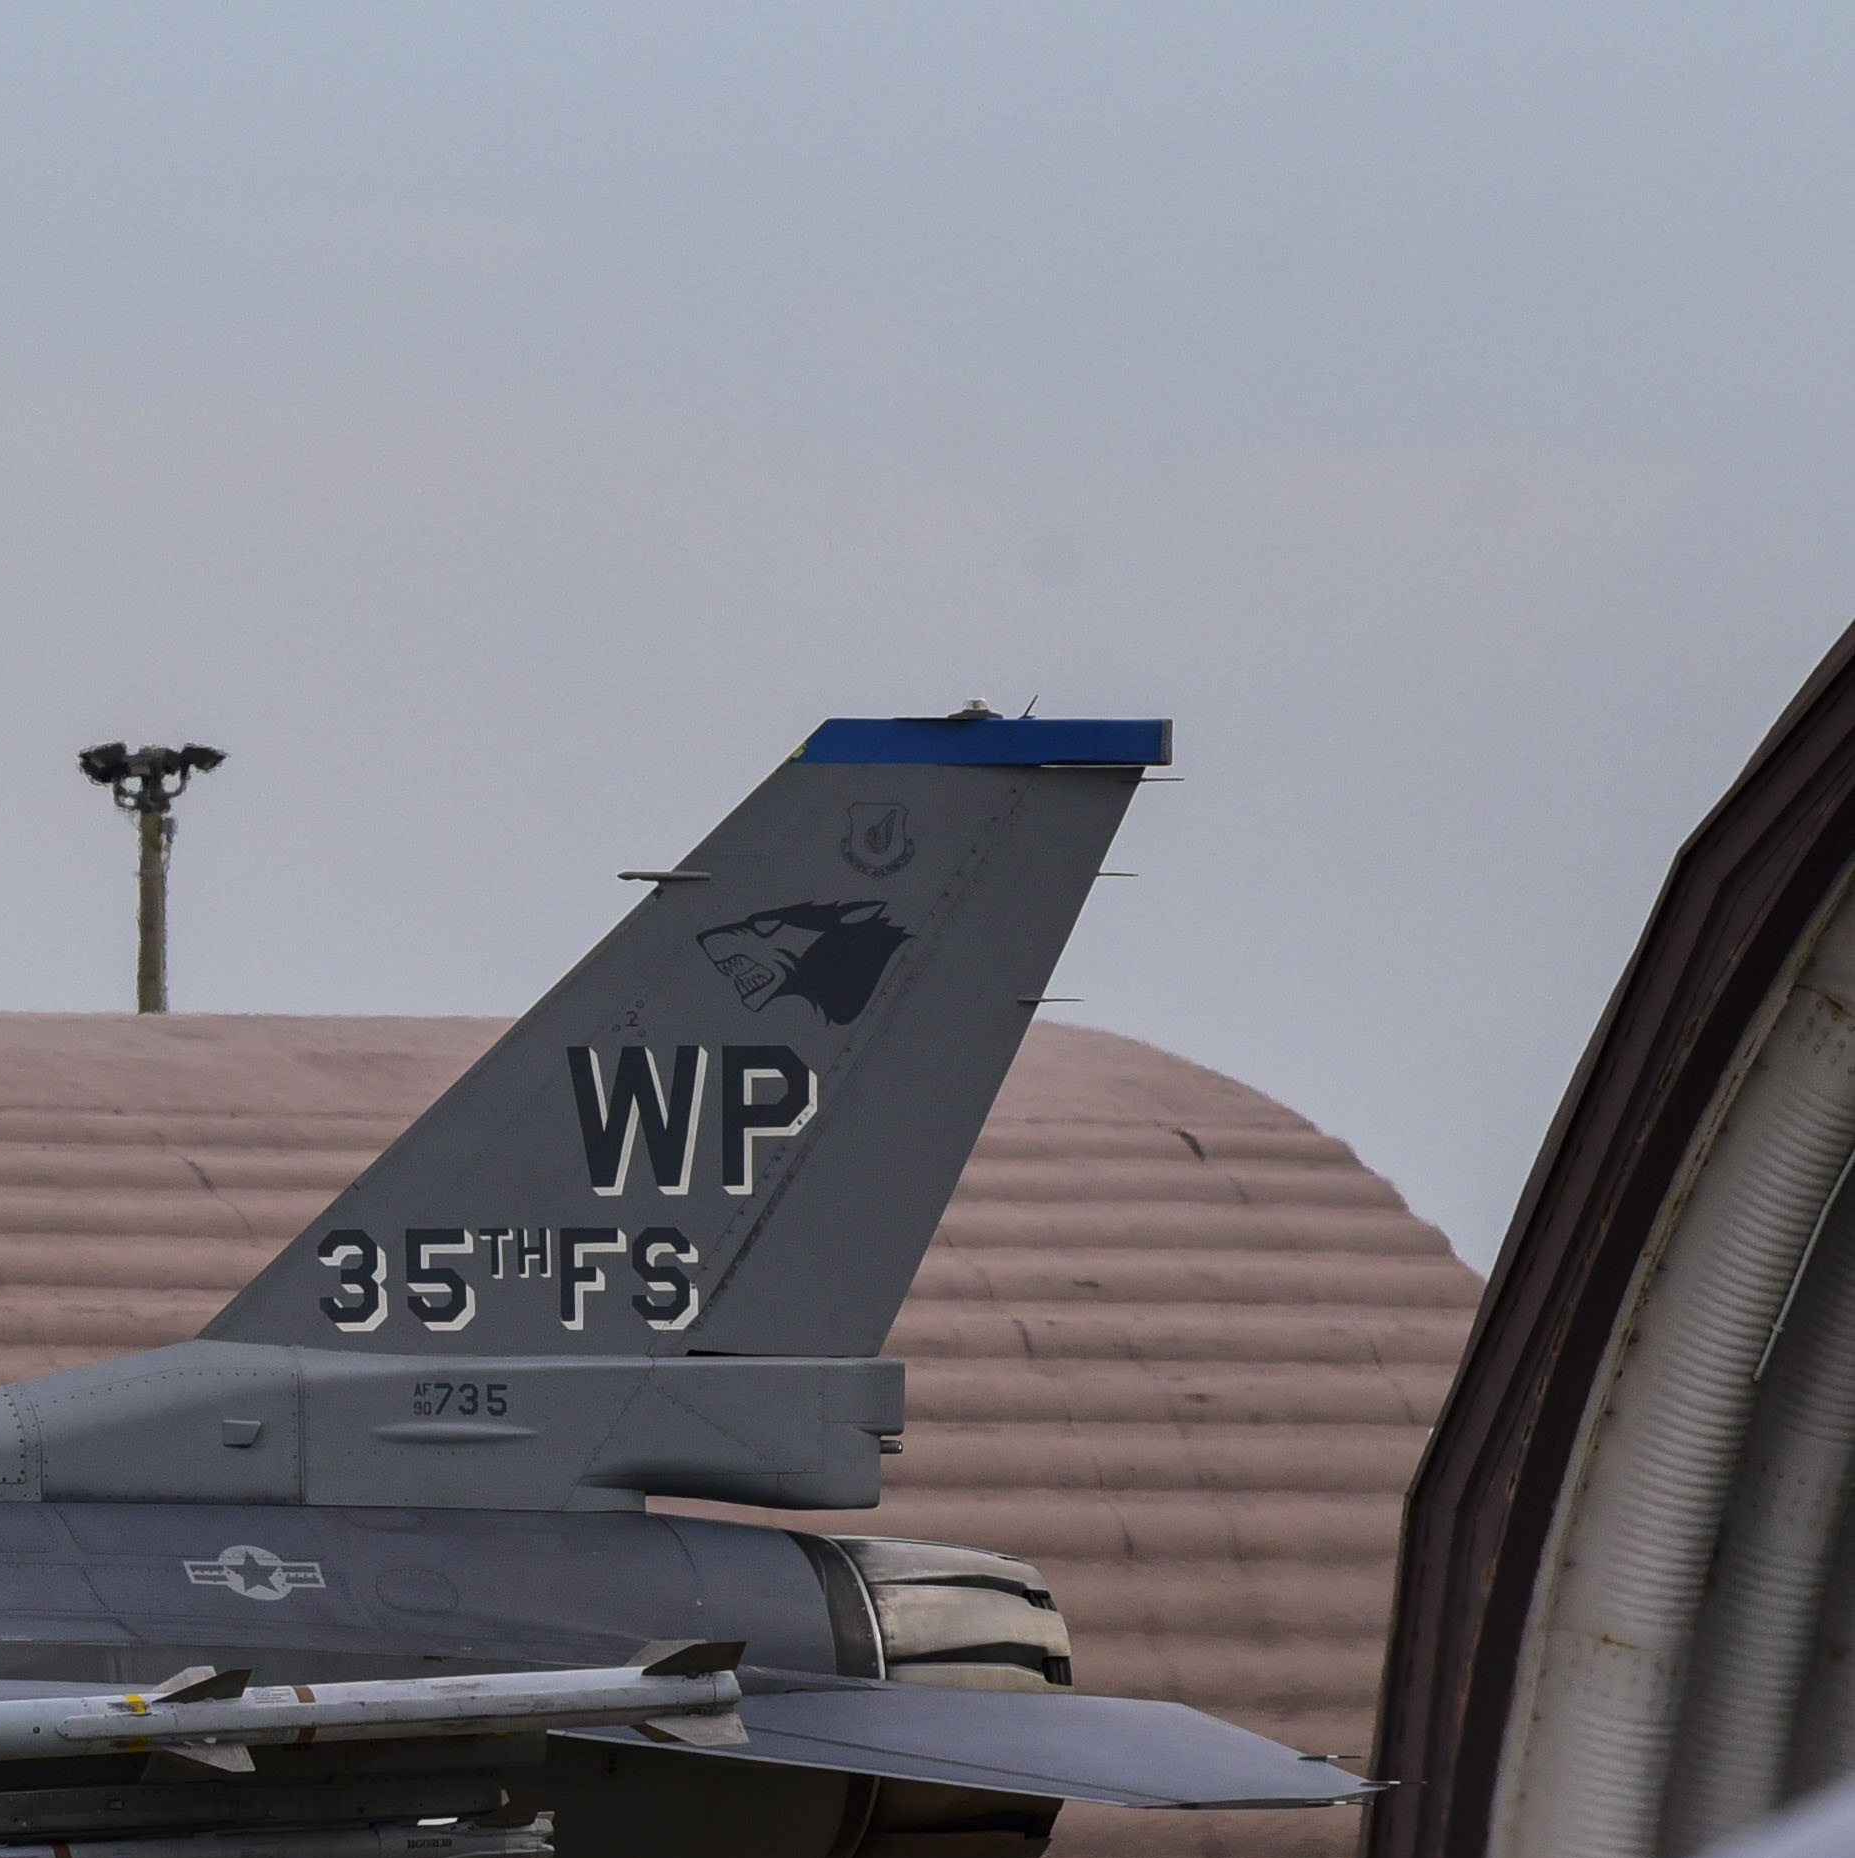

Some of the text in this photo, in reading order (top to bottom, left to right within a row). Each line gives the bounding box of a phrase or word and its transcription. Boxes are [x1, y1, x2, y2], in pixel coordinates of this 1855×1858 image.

[566, 1045, 818, 1197] WP
[413, 1382, 432, 1397] AF
[434, 1382, 508, 1417] 735
[413, 1401, 432, 1416] 90
